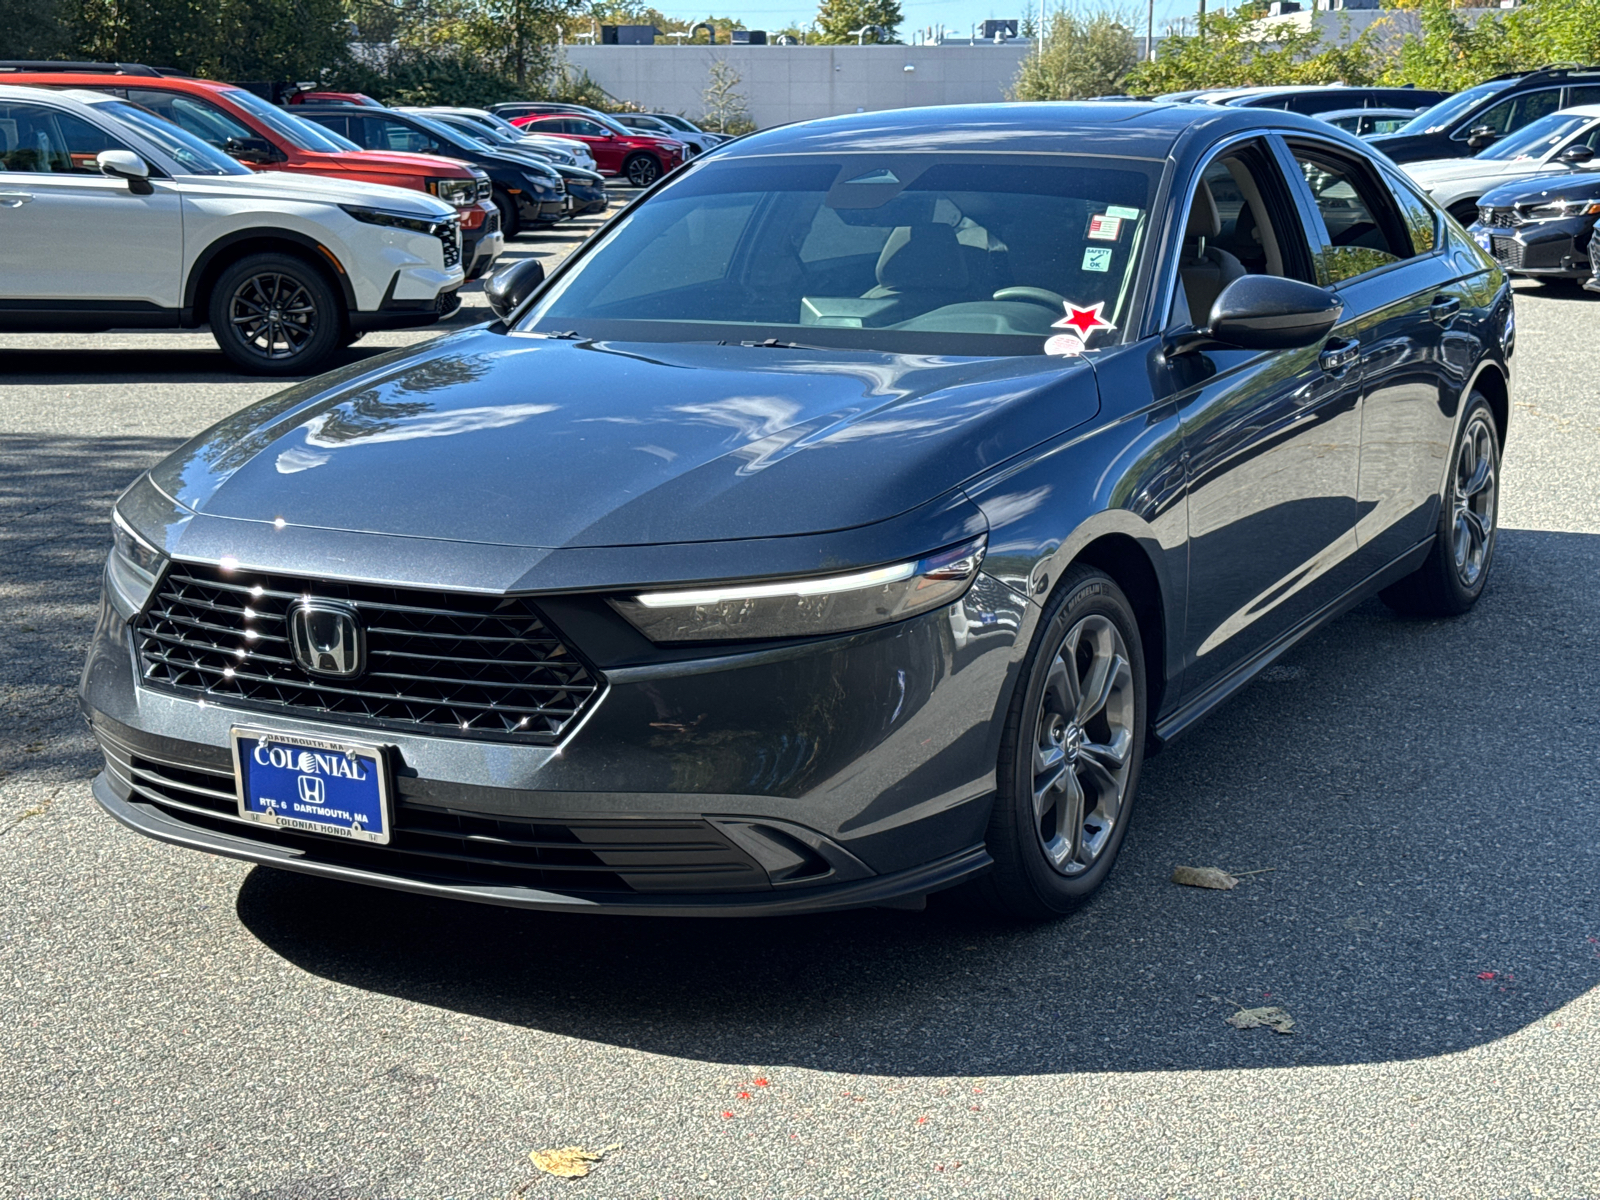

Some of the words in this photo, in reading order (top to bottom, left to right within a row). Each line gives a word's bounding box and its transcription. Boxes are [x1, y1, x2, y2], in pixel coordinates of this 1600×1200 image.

[1067, 583, 1100, 612] MICHELIN
[330, 743, 345, 751] MA
[254, 745, 366, 781] COLONIAL
[259, 797, 280, 809] RTE.
[281, 801, 287, 809] 6
[294, 803, 353, 821] DARTMOUTH,
[354, 813, 369, 823] MA
[276, 817, 318, 831] COLONIAL
[321, 824, 353, 837] HONDA
